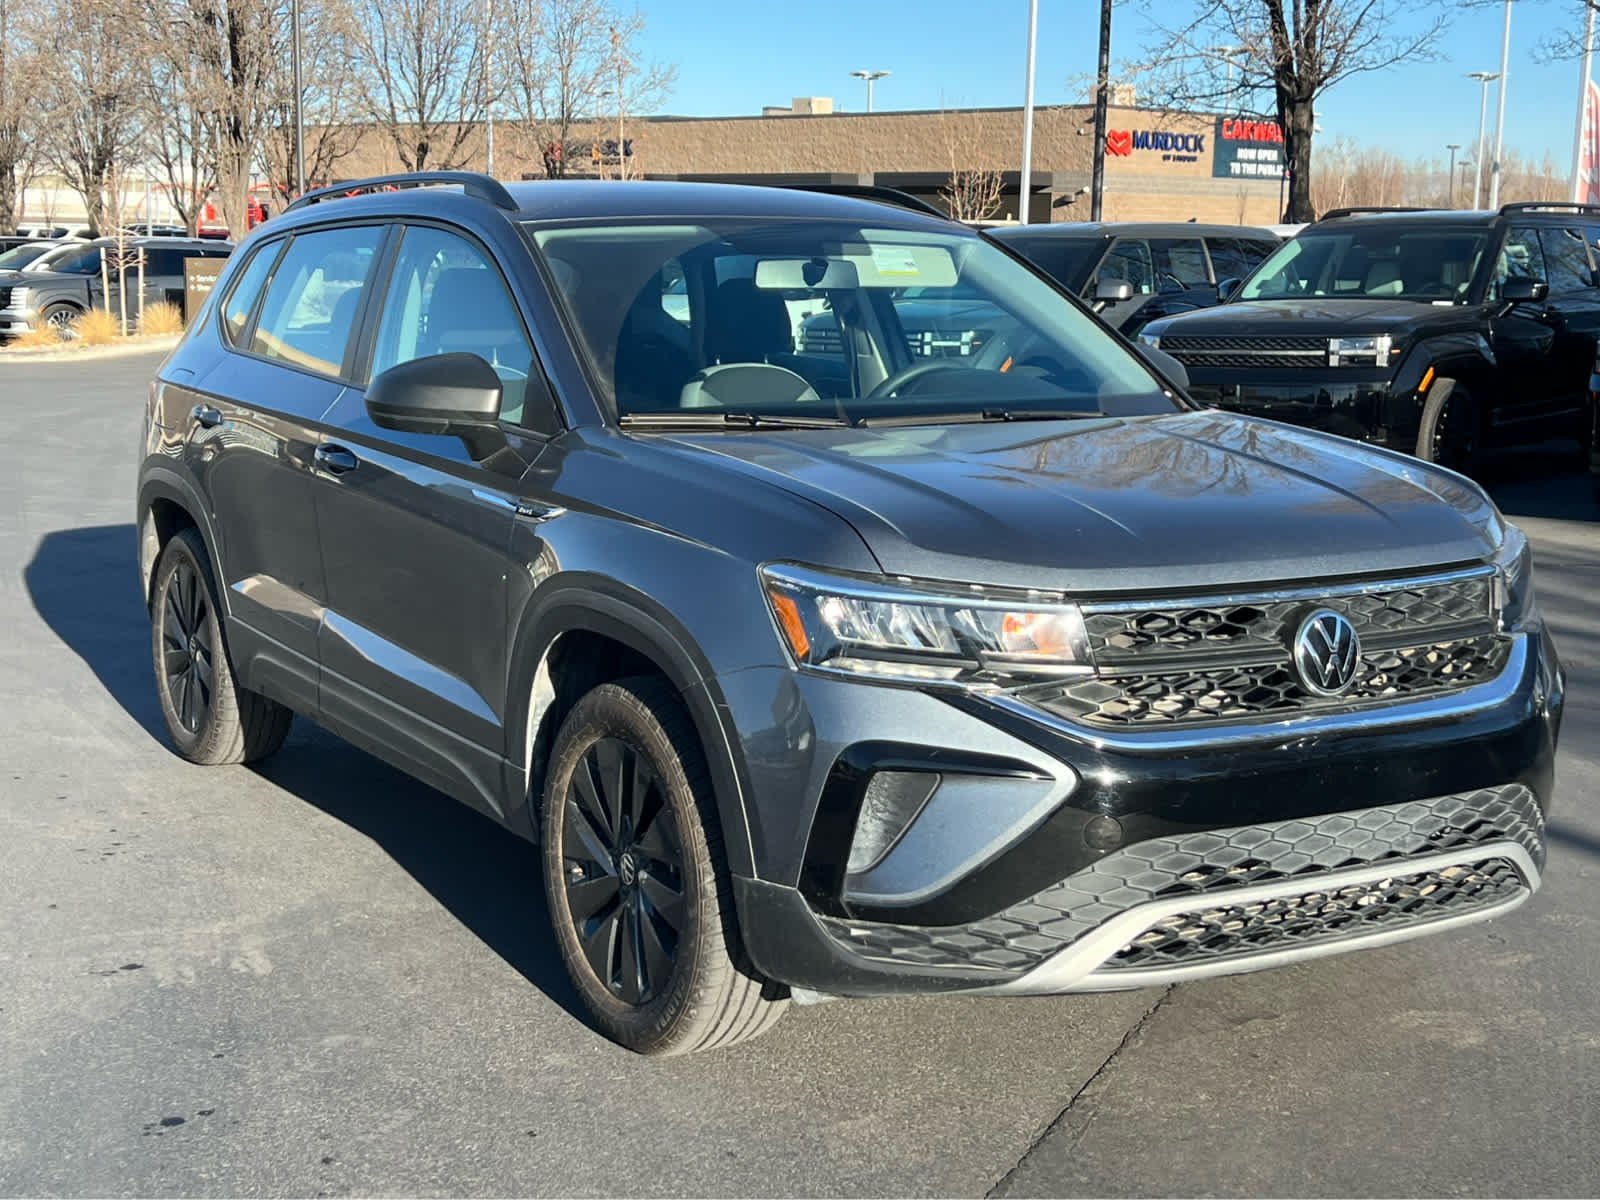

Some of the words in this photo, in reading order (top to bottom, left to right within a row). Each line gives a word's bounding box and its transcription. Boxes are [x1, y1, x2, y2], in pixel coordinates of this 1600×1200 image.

[1132, 129, 1205, 152] MURDOCK
[1237, 148, 1256, 160] NOW
[1257, 149, 1278, 161] OPEN
[1230, 162, 1240, 175] TO
[1241, 163, 1256, 175] THE
